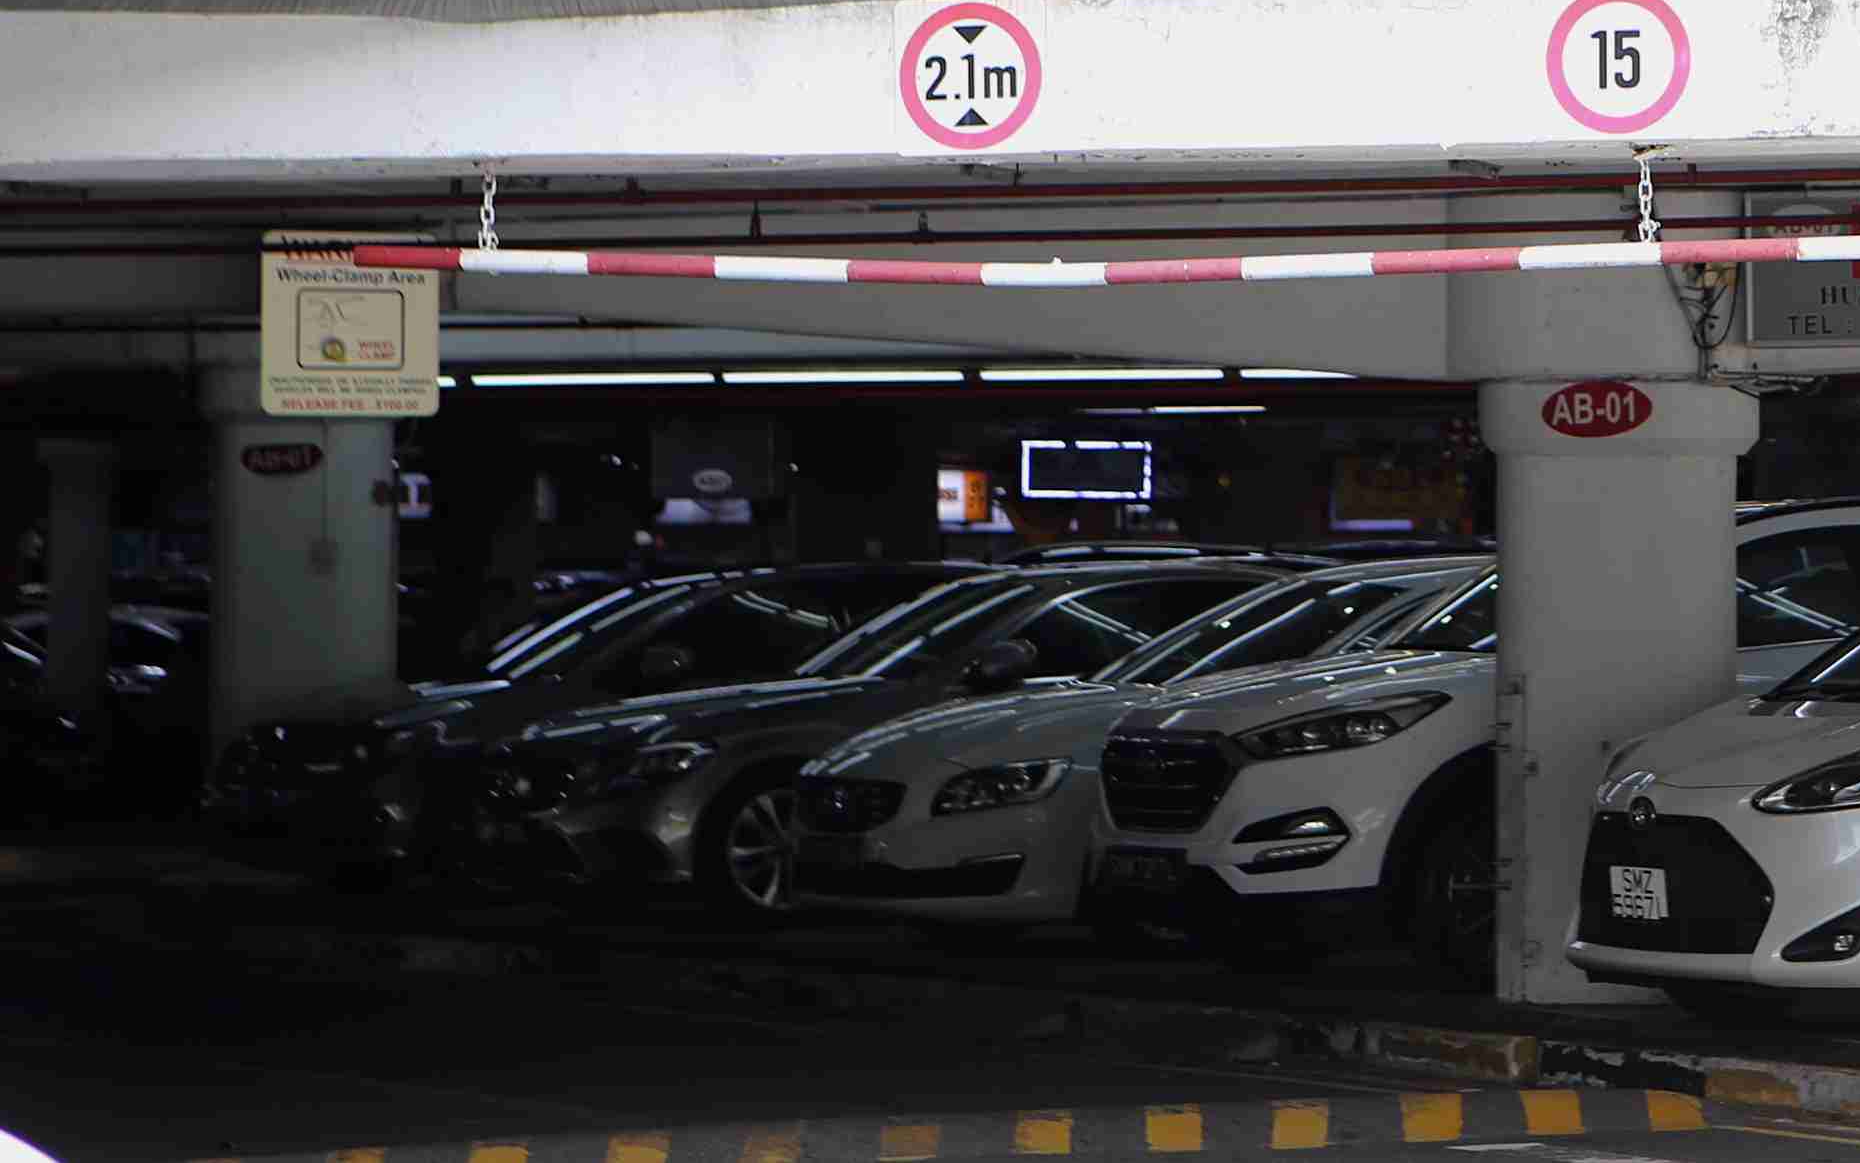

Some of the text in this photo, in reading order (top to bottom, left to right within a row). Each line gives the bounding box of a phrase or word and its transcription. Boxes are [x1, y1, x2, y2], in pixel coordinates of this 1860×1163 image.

[924, 53, 1018, 101] 2.1m
[1590, 29, 1642, 90] 15
[277, 267, 426, 286] Wheel-Clamp Area
[1788, 315, 1832, 336] TEL
[1551, 390, 1636, 426] AB-01
